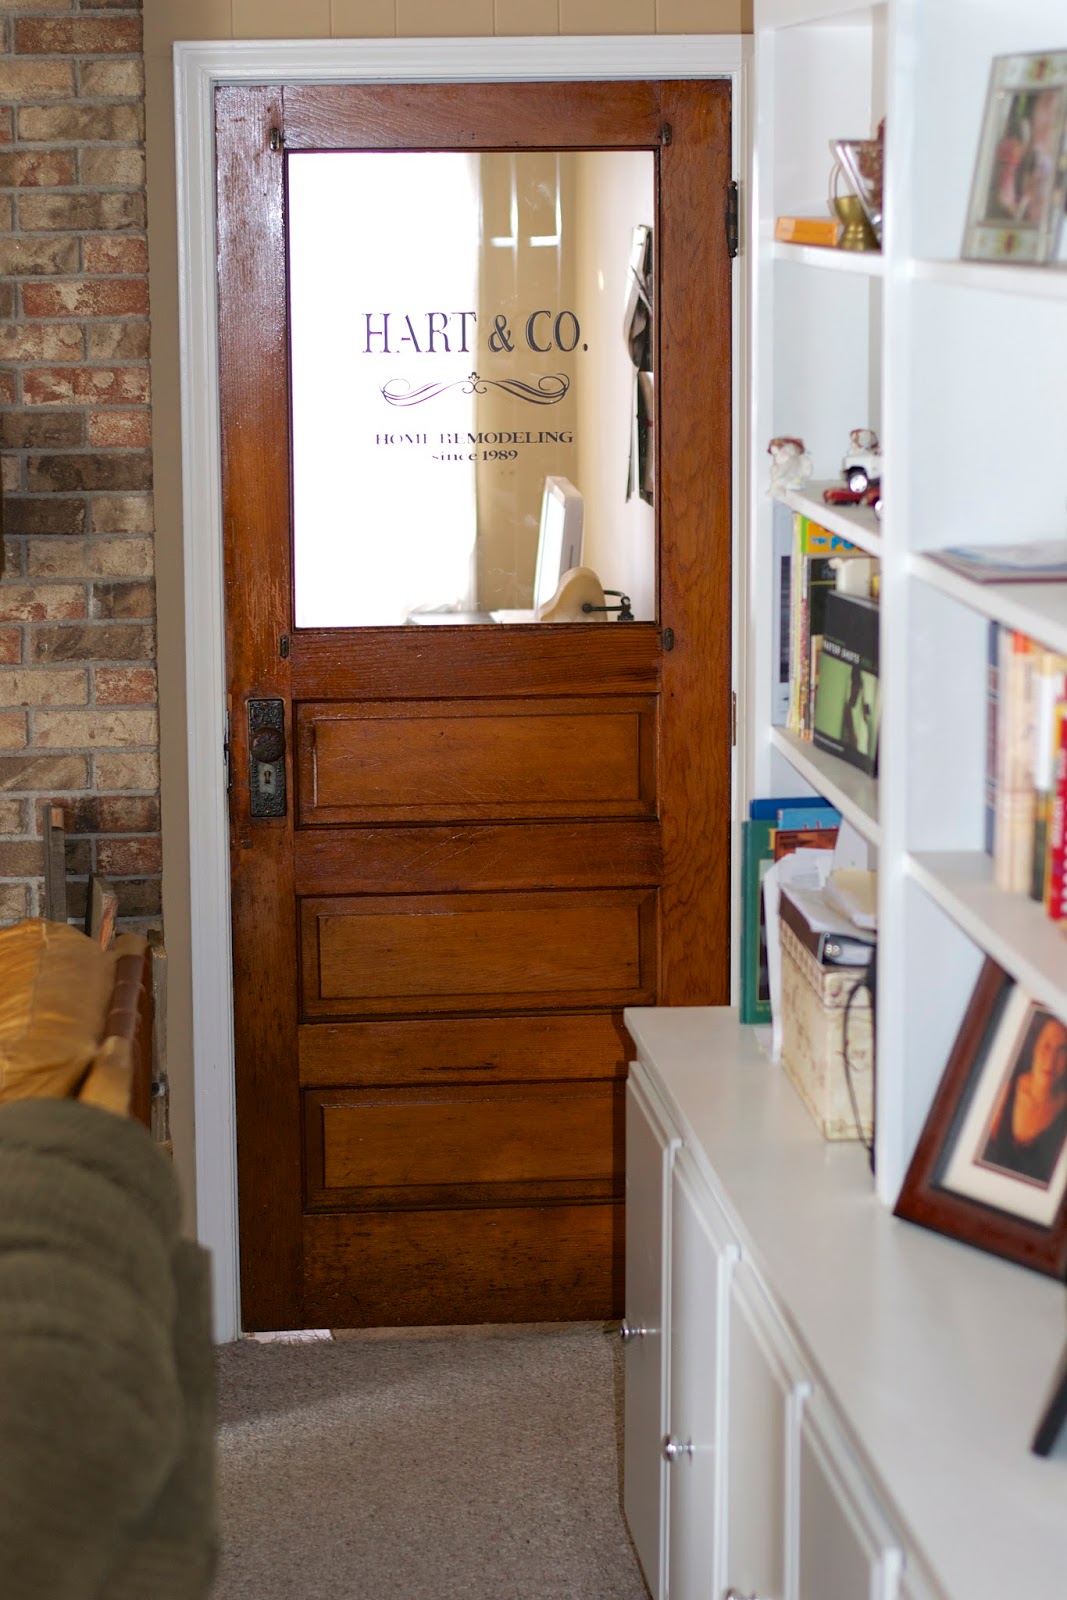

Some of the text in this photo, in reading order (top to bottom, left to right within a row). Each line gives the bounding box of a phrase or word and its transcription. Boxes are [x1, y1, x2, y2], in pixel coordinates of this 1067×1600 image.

[361, 310, 589, 354] HART & CO.
[440, 431, 574, 445] REMODELING
[431, 449, 519, 461] since 1989
